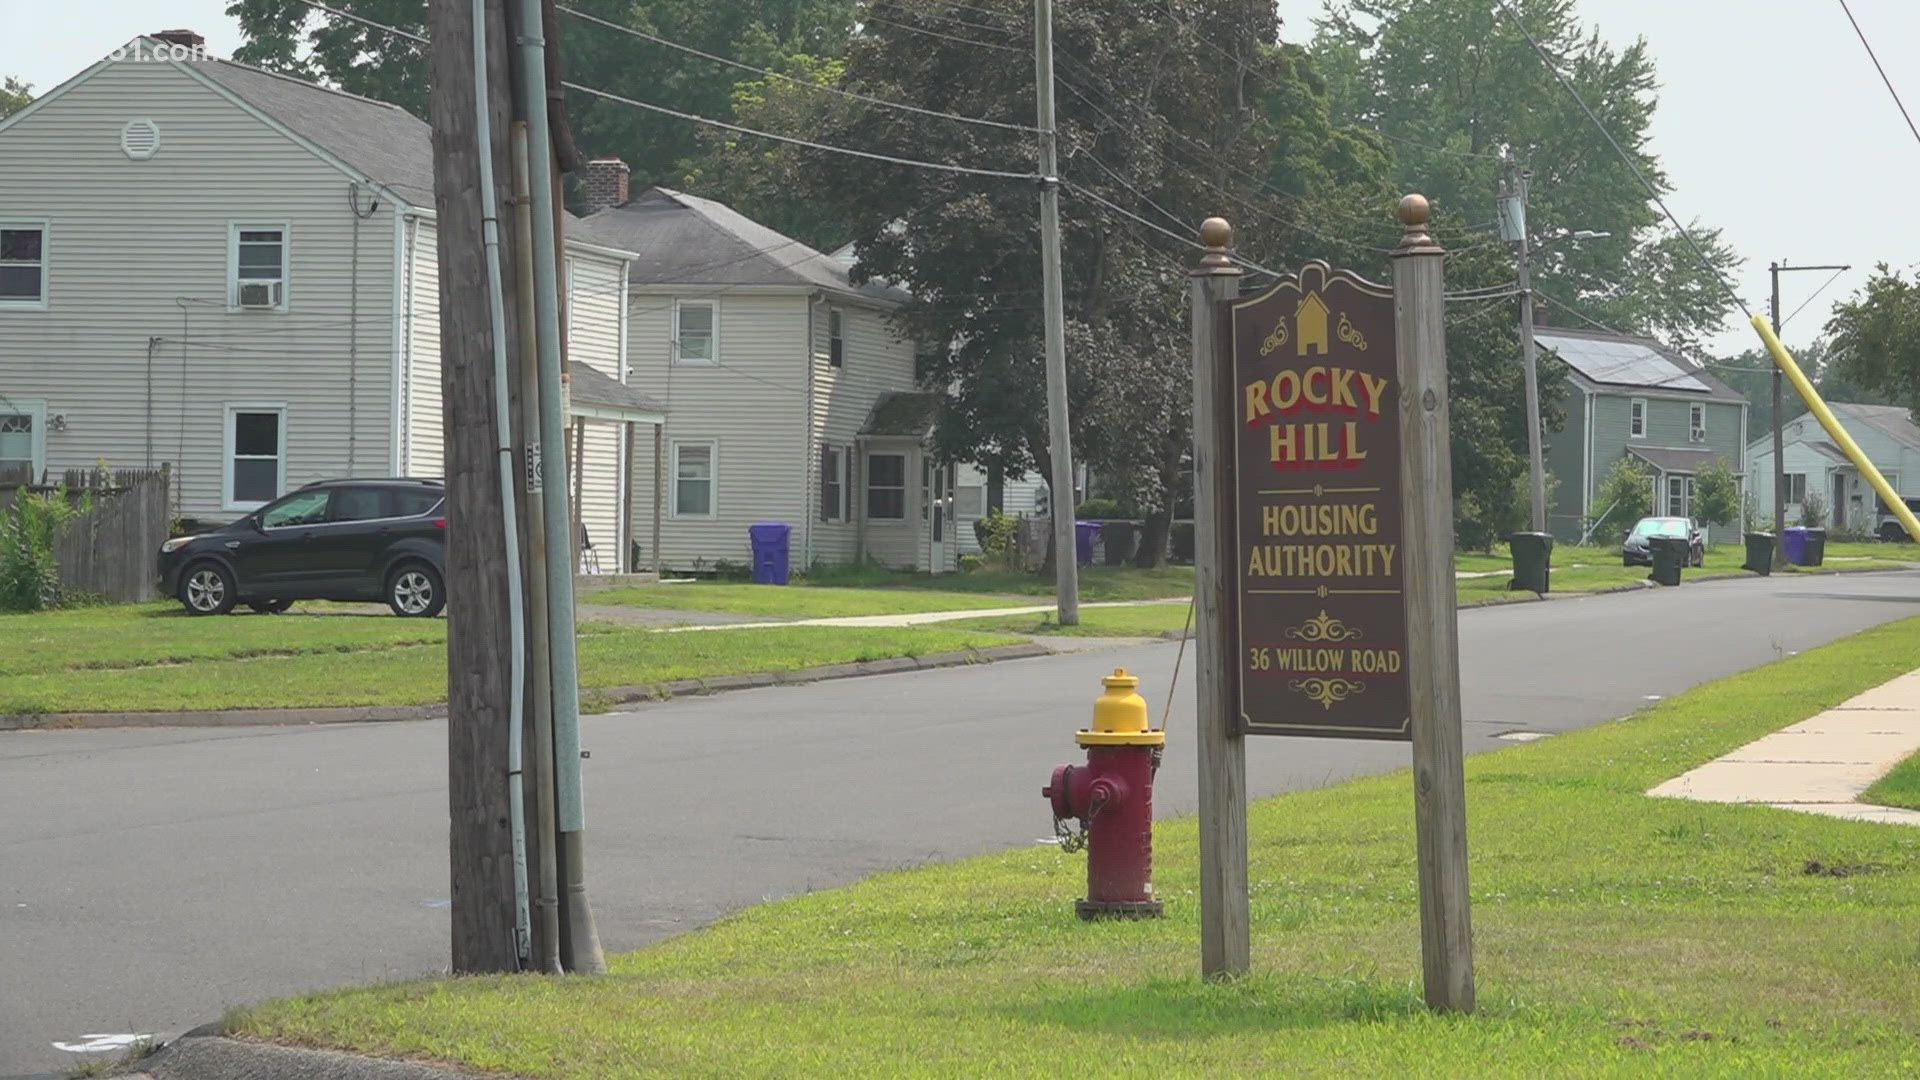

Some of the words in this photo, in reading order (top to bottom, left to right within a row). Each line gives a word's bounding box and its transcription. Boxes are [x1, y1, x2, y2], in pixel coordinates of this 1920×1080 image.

[1245, 366, 1388, 425] ROCKY
[1270, 421, 1368, 466] HILL
[1262, 503, 1378, 536] HOUSING
[1248, 544, 1396, 576] AUTHORITY
[1250, 648, 1270, 670] 36
[1277, 649, 1344, 672] WILLOW
[1352, 650, 1400, 673] ROAD
